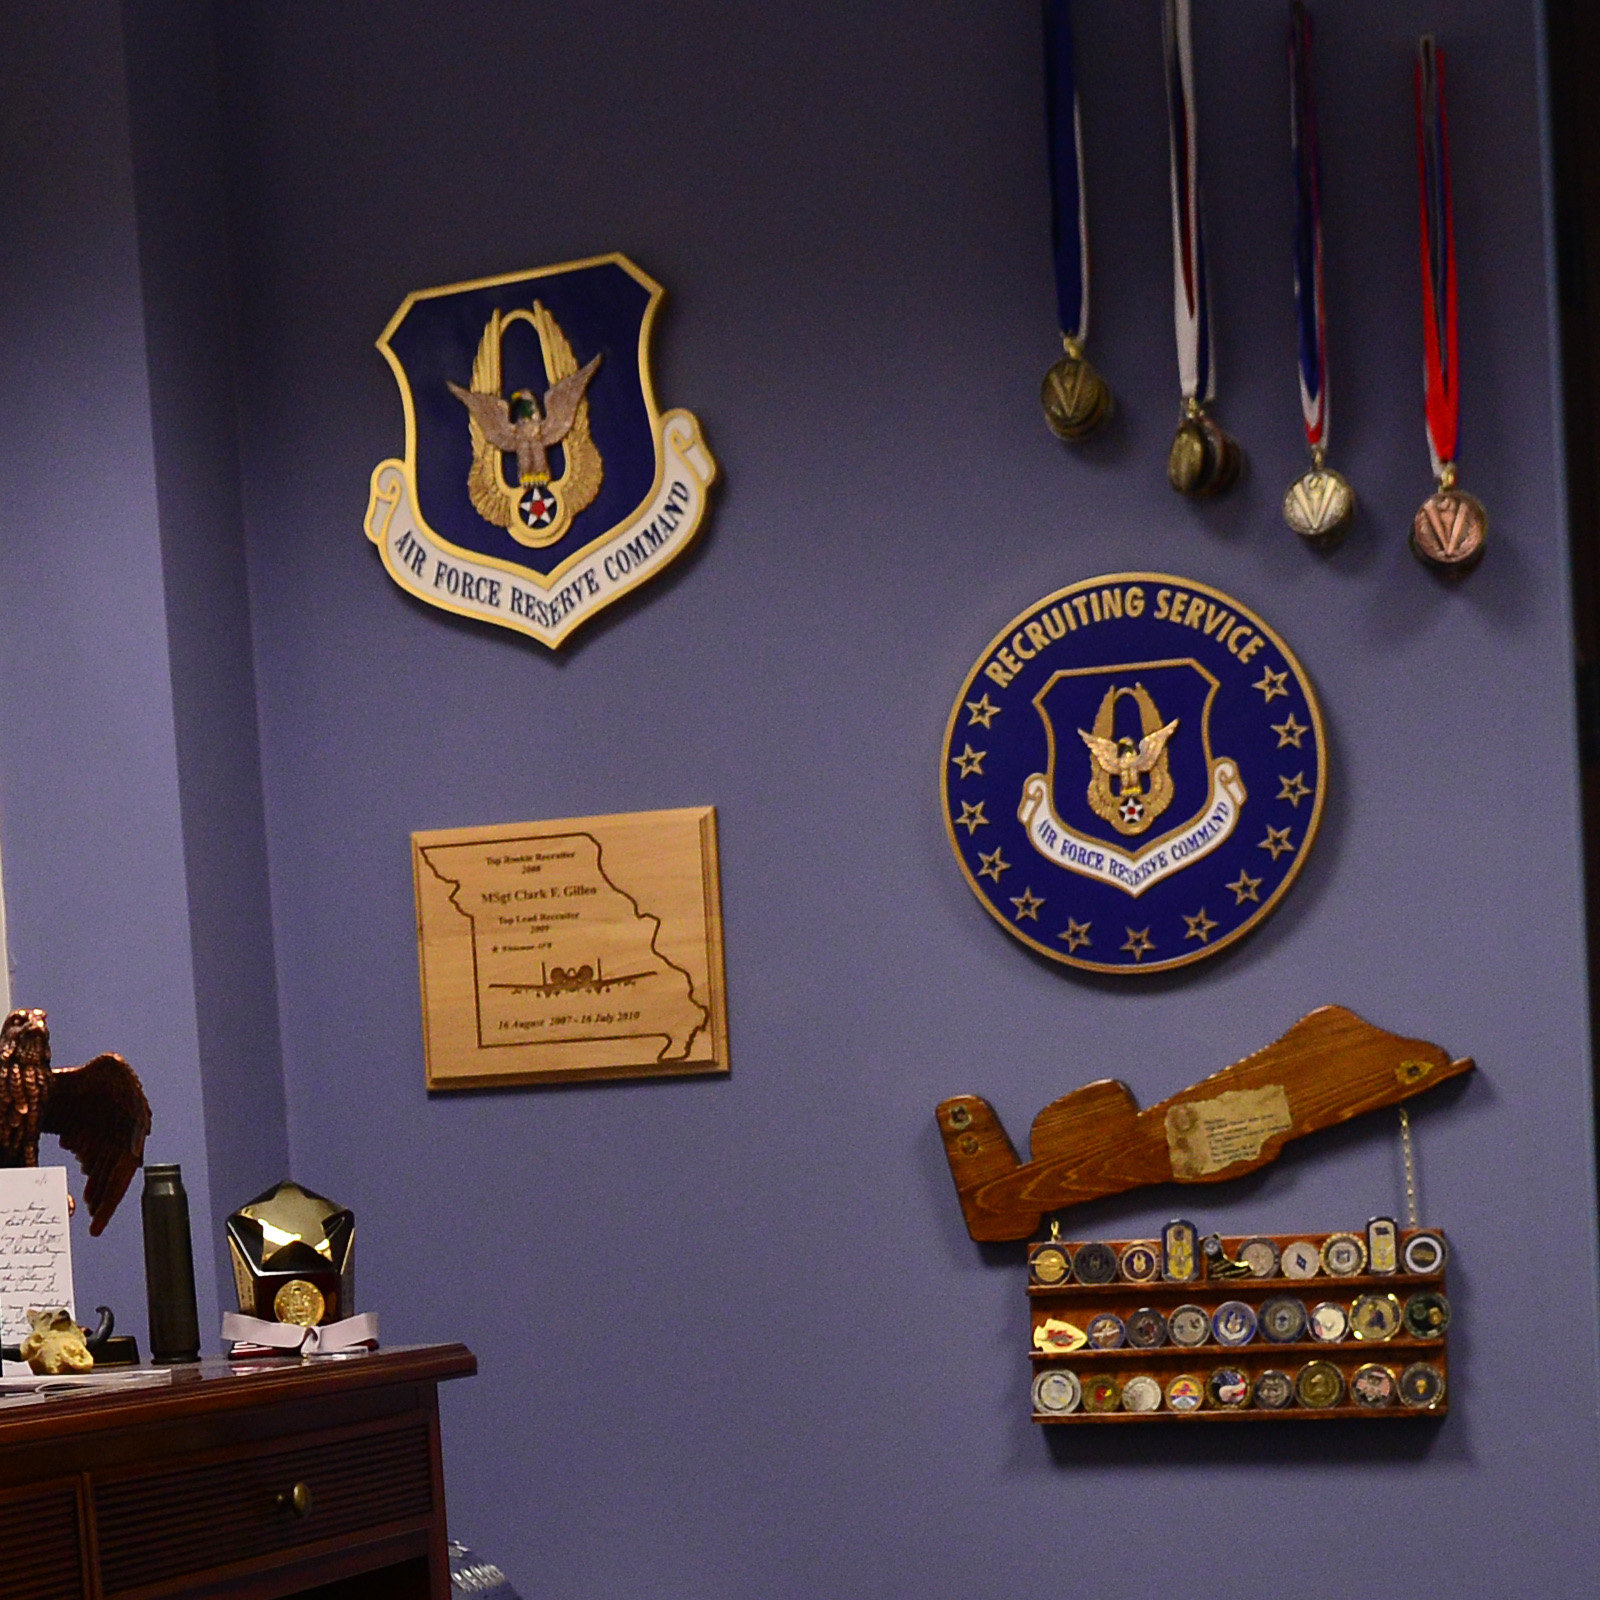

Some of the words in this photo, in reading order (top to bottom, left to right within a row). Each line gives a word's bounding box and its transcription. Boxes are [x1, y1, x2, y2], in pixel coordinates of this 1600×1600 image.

[393, 529, 429, 579] AIR
[432, 560, 501, 608] FORCE
[509, 568, 601, 629] RESERVE
[602, 478, 691, 582] COMMAND
[983, 585, 1147, 689] RECRUITING
[1153, 588, 1266, 665] SERVICE
[1036, 819, 1059, 848] AIR
[1059, 838, 1105, 873] FORCE
[1108, 850, 1168, 887] RESERVE
[1170, 800, 1230, 861] COMMAND
[482, 891, 512, 905] MSgt
[514, 888, 549, 902] Clark
